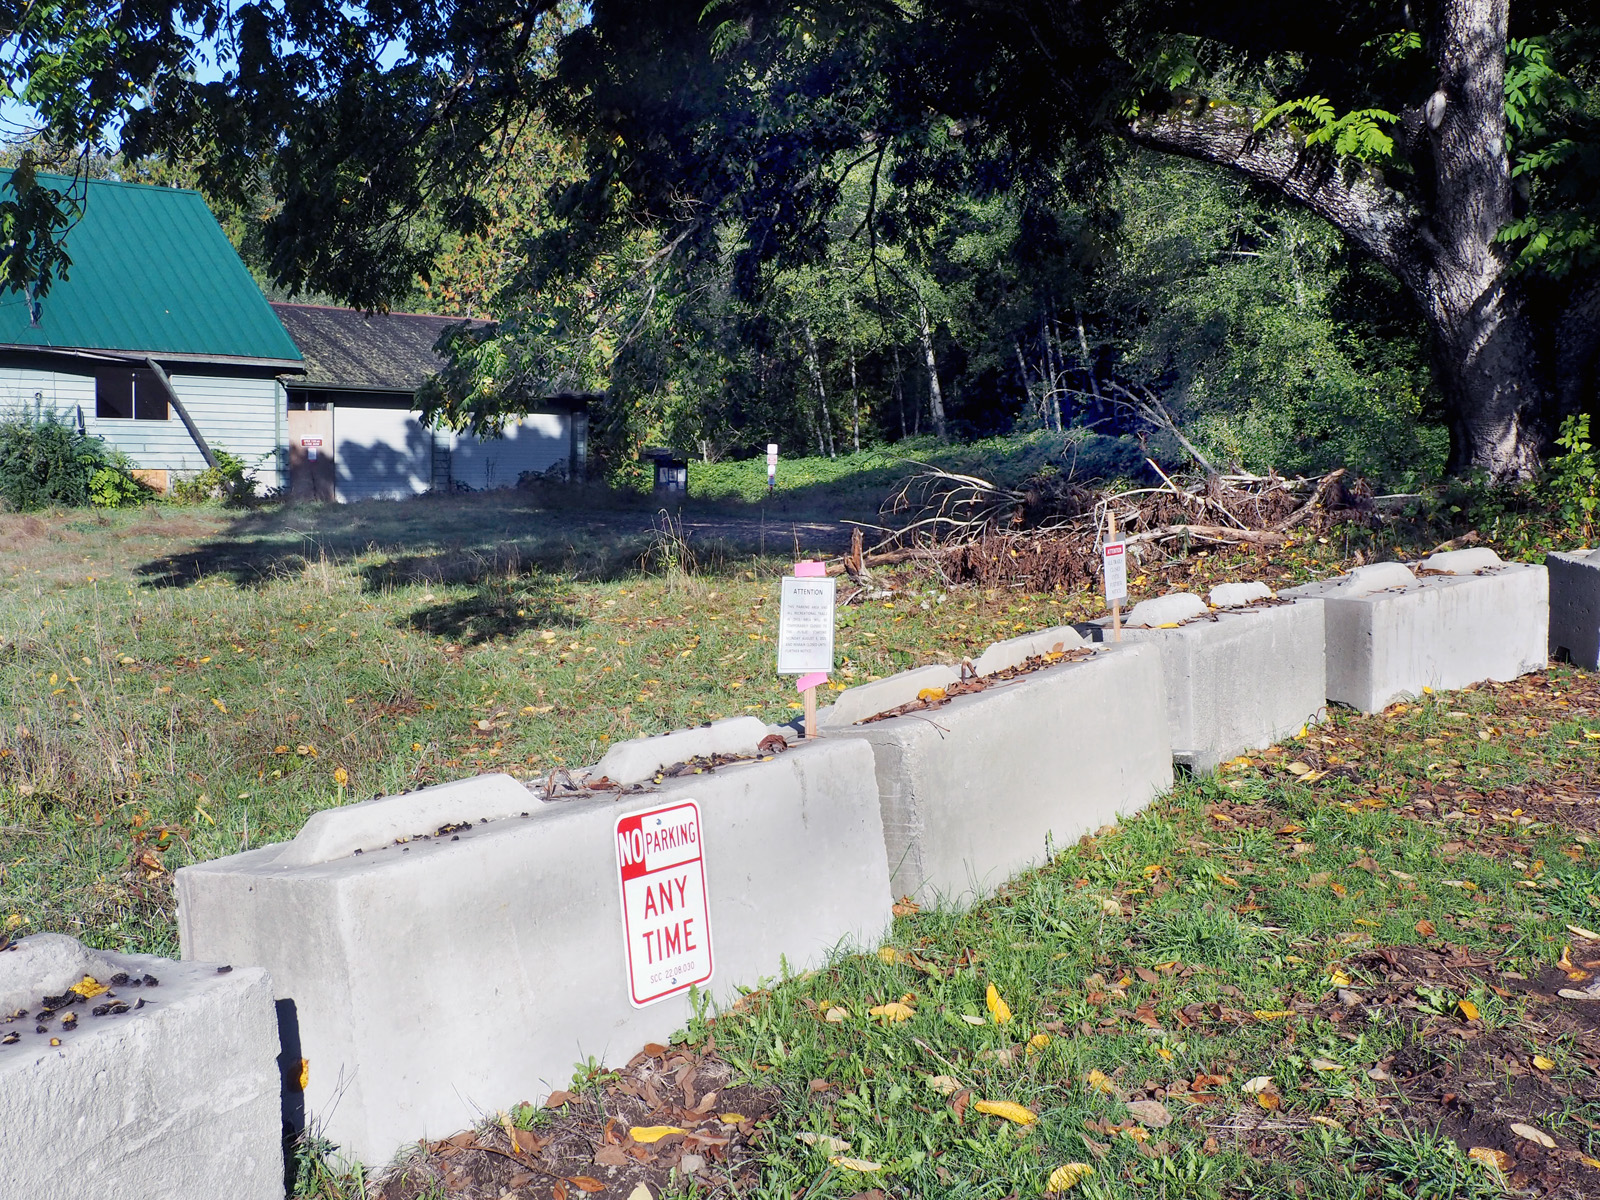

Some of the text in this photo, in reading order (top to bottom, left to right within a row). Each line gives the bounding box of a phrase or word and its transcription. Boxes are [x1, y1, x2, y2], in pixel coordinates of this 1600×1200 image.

[618, 821, 696, 867] NO PARKING
[644, 874, 688, 920] ANY
[642, 918, 697, 965] TIME
[650, 961, 695, 984] SCC 22.08.030
